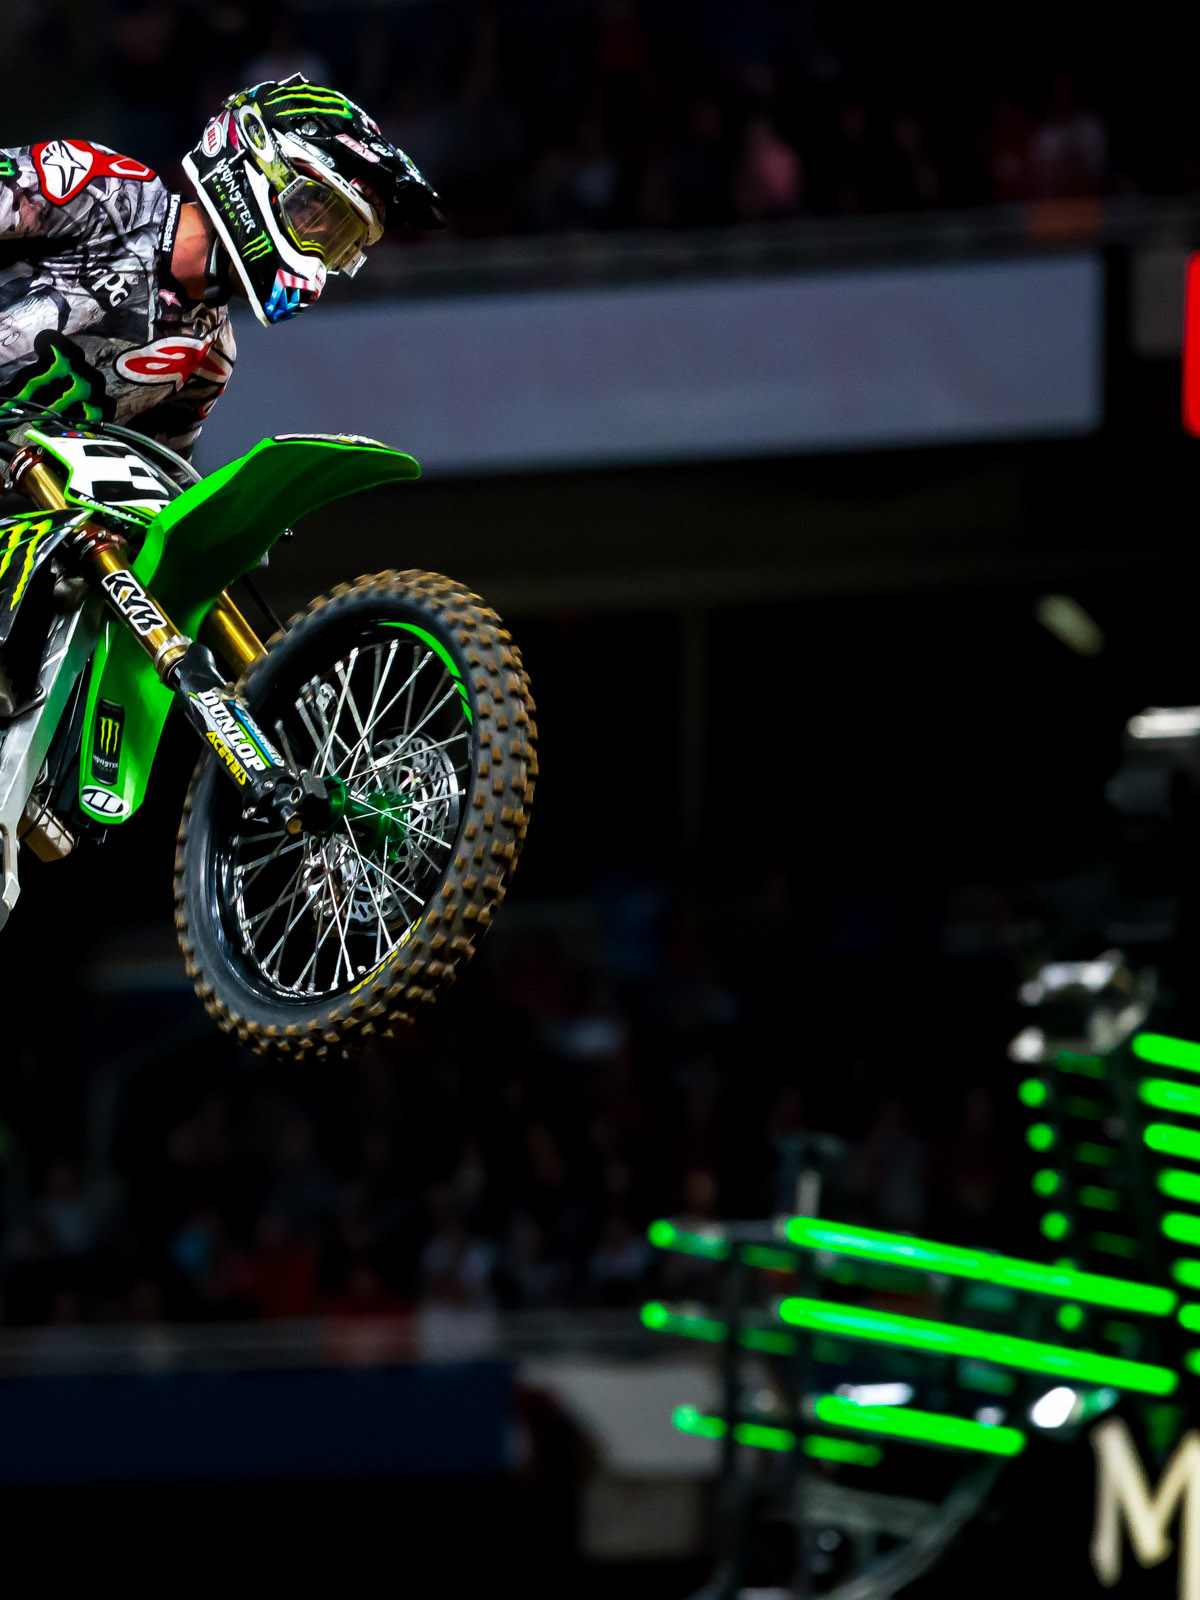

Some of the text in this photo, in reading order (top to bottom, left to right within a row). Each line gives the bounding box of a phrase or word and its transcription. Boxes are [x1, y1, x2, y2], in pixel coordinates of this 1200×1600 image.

[206, 127, 219, 153] BELL
[161, 194, 181, 252] Kawasaki
[101, 569, 168, 635] KYB
[197, 688, 267, 772] DUNLOP
[205, 731, 248, 786] ACERBIS
